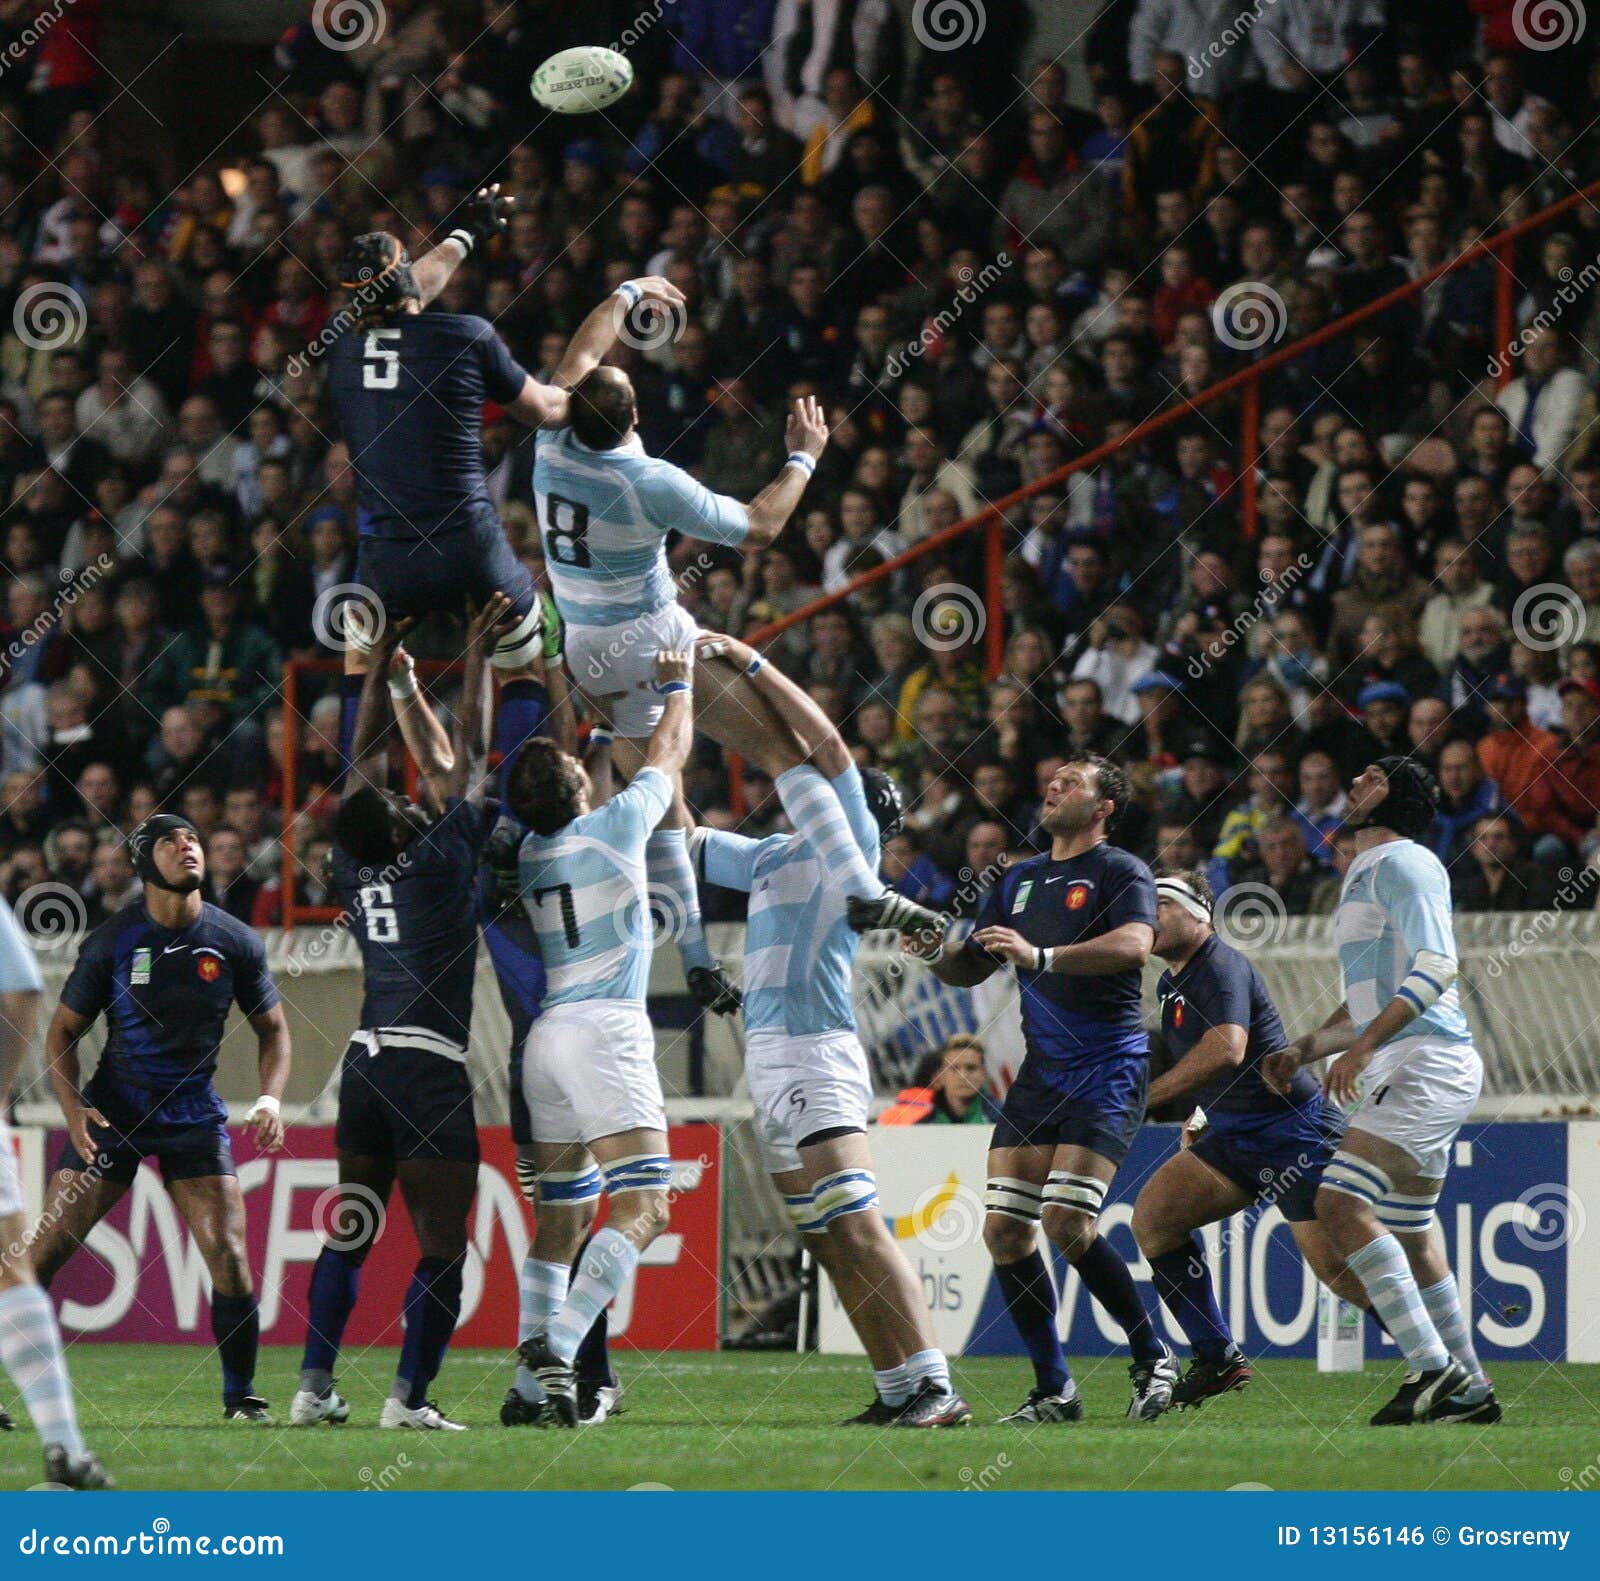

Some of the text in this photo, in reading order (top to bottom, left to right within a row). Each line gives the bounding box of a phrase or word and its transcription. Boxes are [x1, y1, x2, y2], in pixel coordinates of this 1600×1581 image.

[363, 328, 401, 389] 5
[546, 492, 591, 569] 8
[361, 885, 399, 942] 6
[533, 882, 580, 949] 7
[790, 1088, 806, 1114] 5
